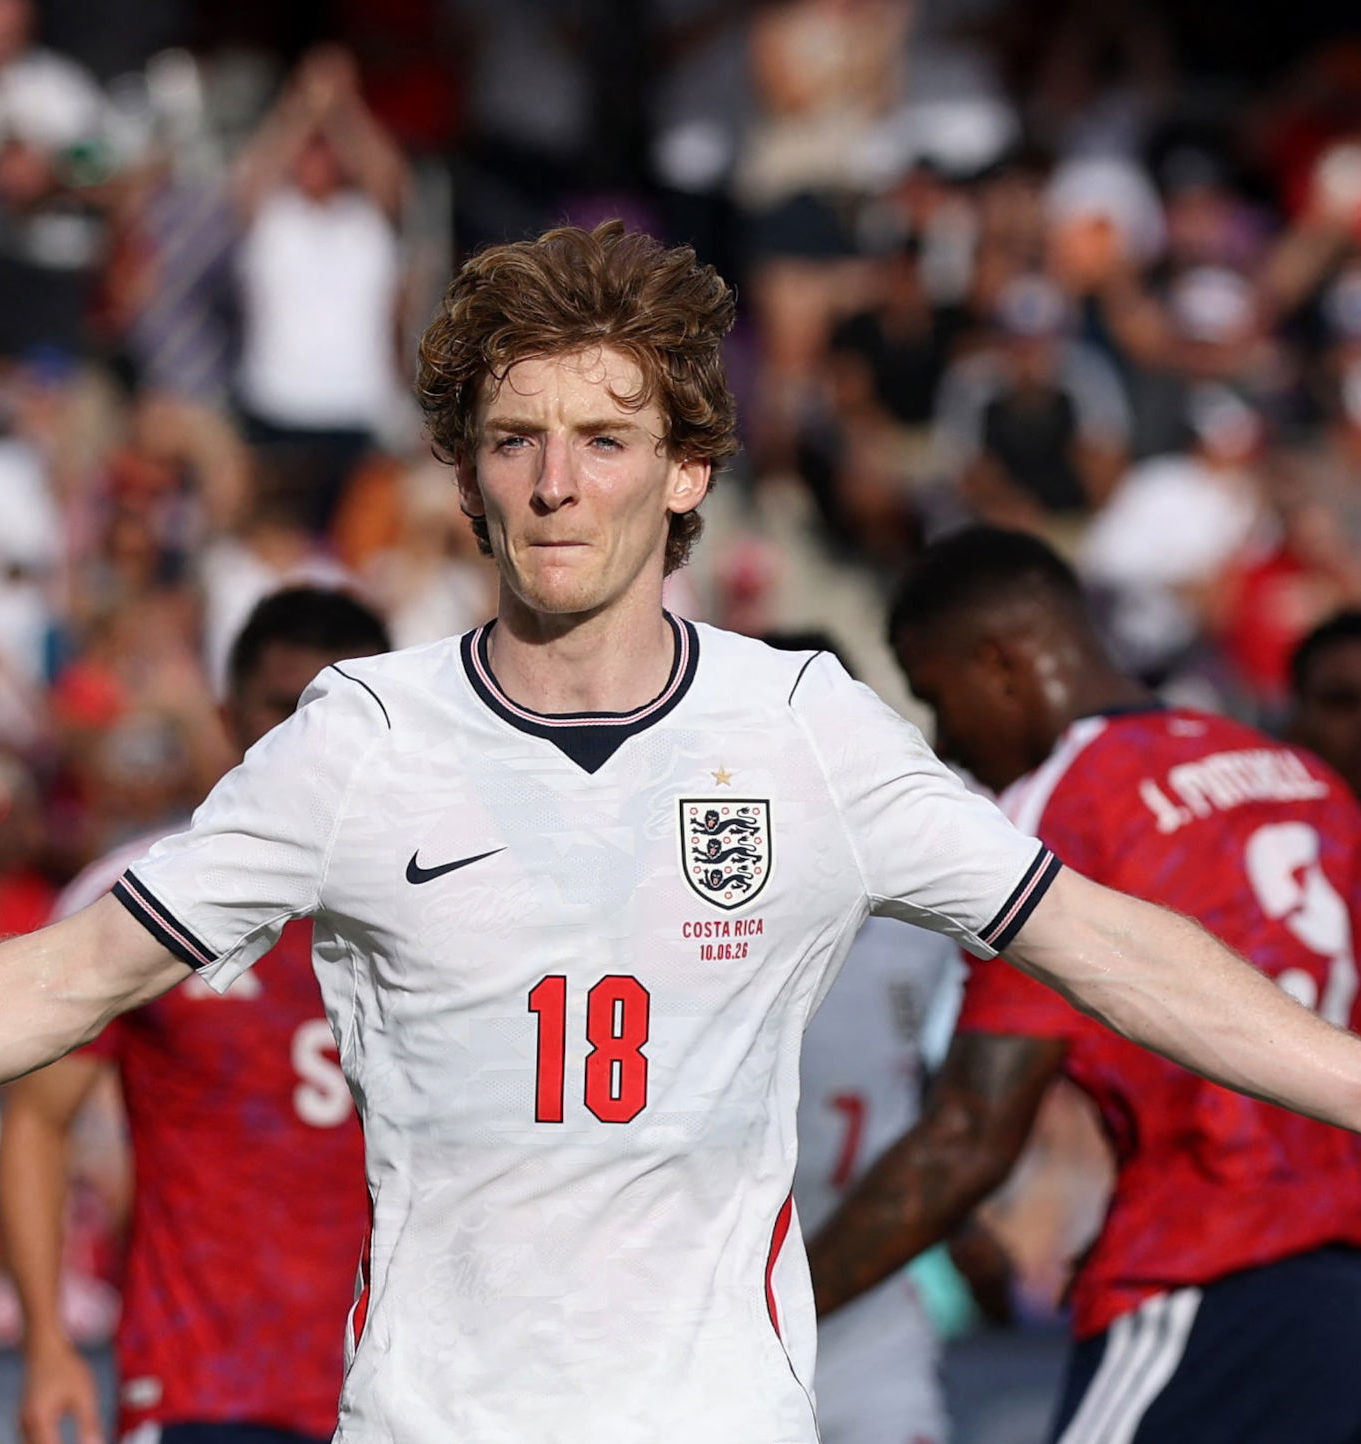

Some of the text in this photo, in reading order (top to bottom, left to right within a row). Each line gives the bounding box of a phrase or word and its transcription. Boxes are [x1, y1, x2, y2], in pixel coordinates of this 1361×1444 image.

[682, 918, 764, 938] COSTA RICA
[700, 941, 749, 961] 10.06.26
[527, 974, 651, 1124] 18
[826, 1088, 871, 1191] 7
